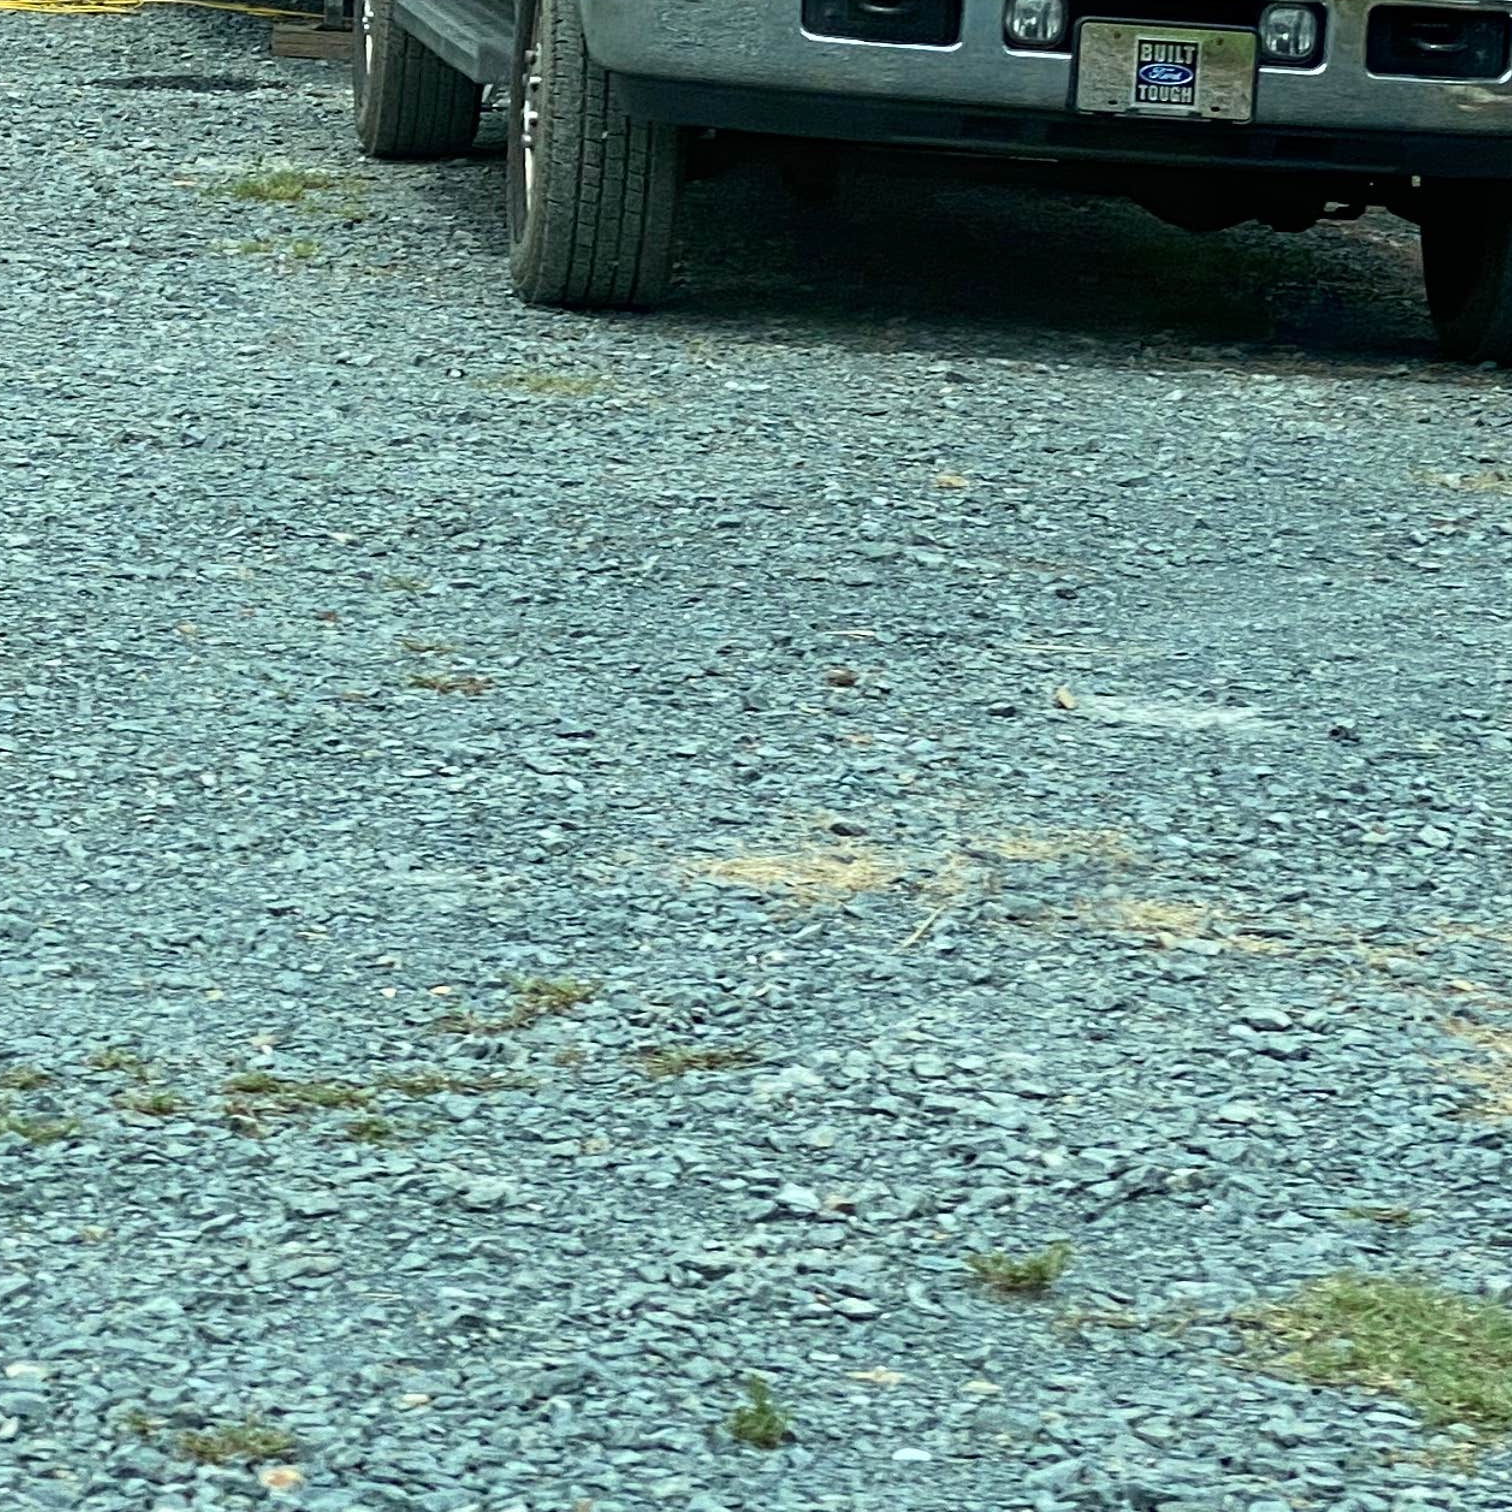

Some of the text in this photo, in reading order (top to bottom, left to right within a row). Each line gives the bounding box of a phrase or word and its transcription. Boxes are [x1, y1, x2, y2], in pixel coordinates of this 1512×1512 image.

[1140, 43, 1196, 65] BUILT
[1148, 66, 1183, 80] Ford
[1138, 84, 1193, 103] TOUGH
